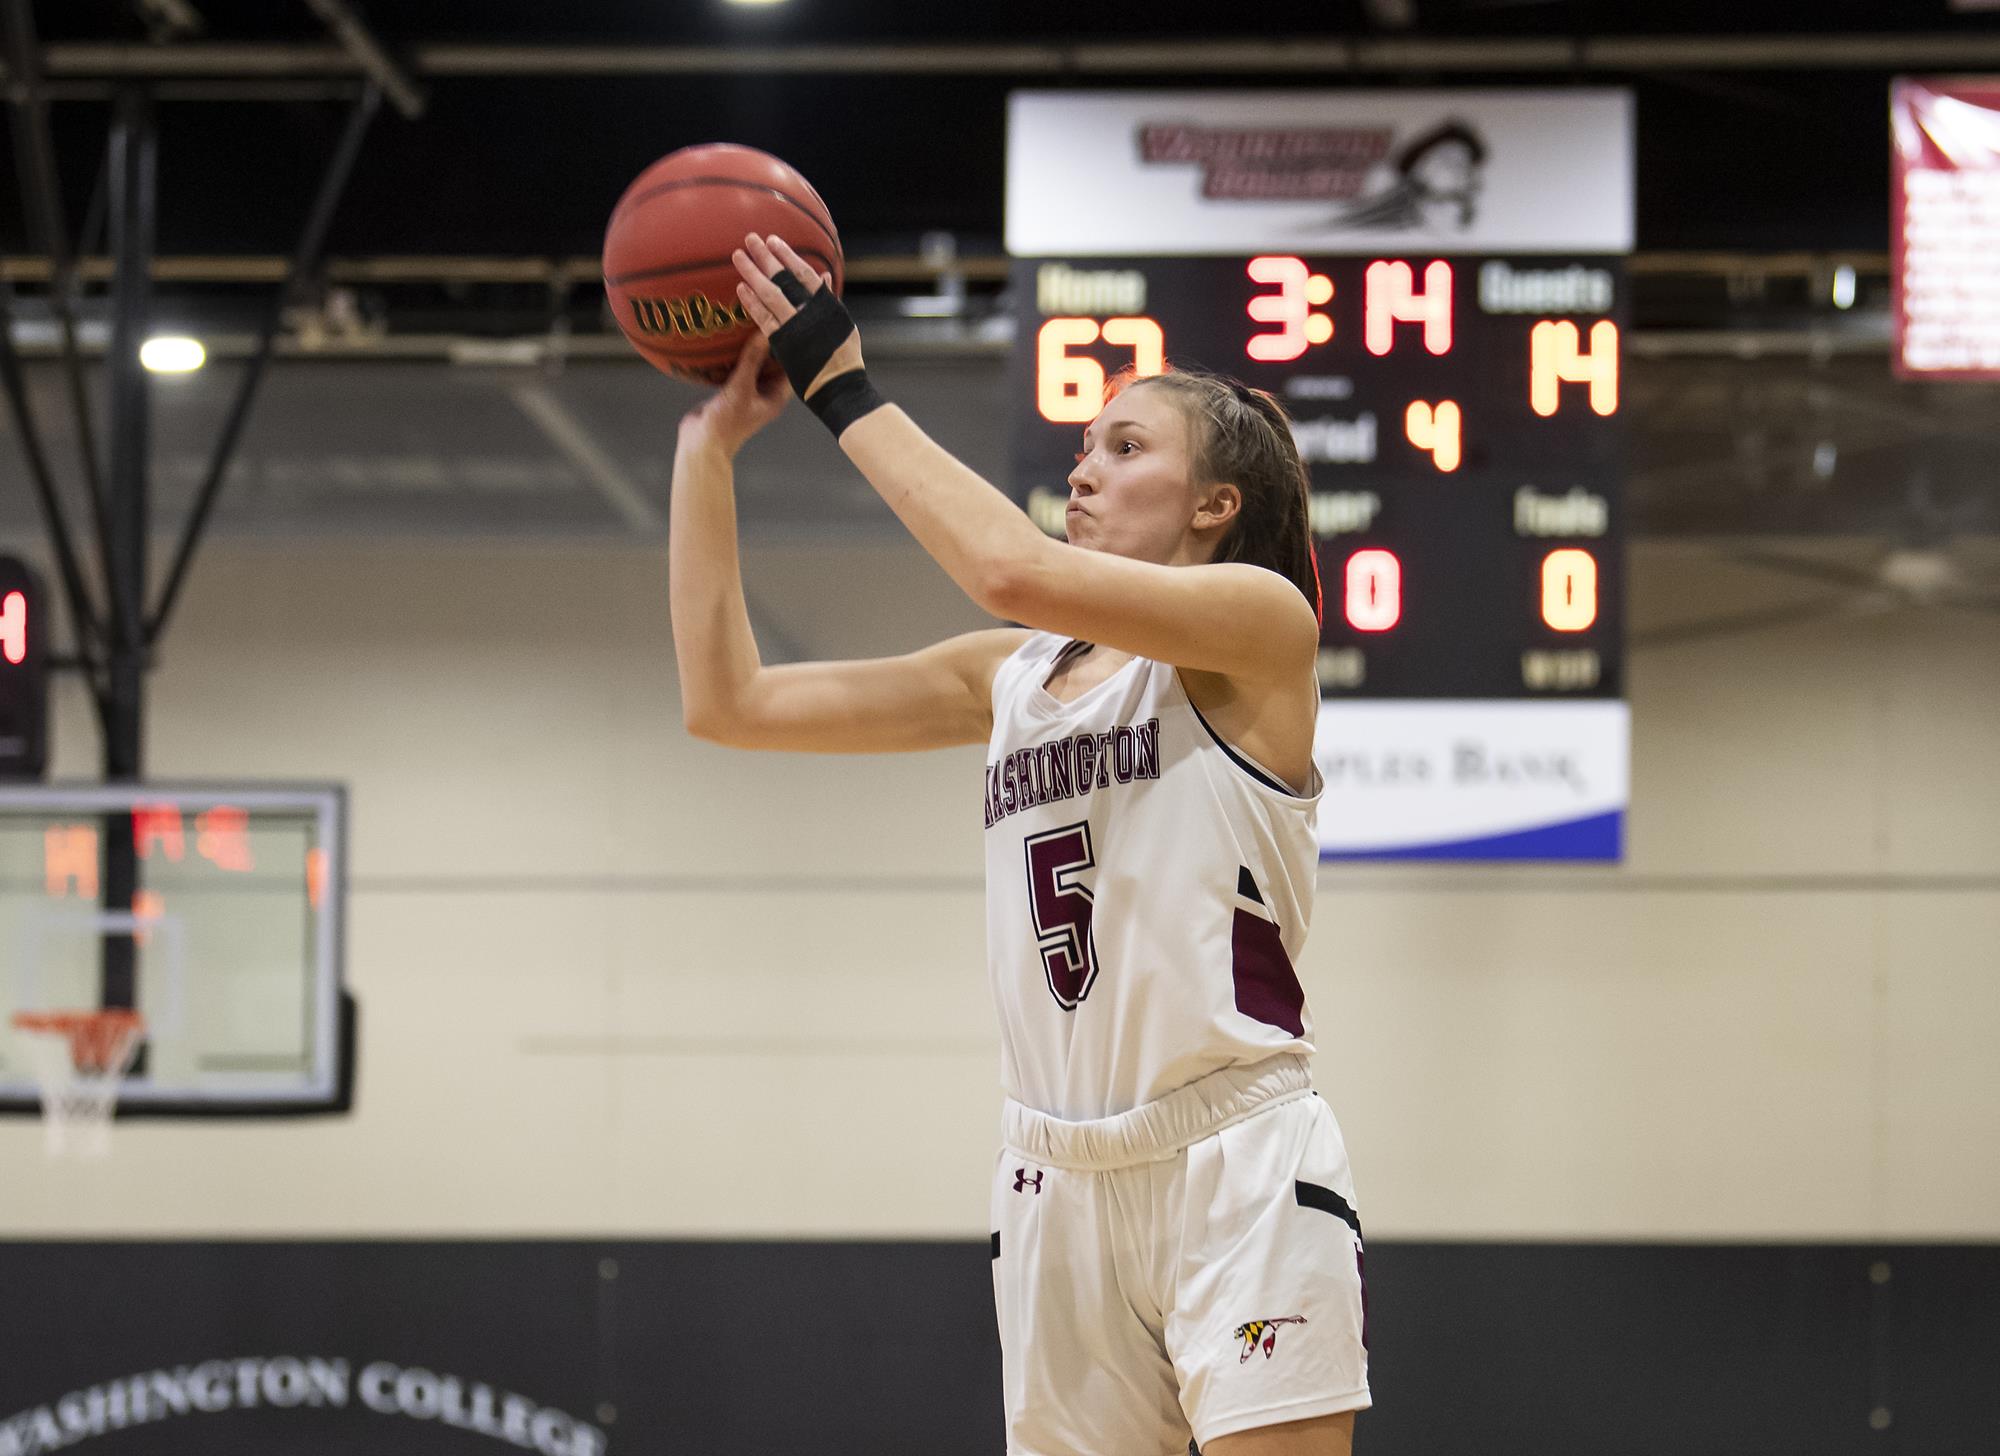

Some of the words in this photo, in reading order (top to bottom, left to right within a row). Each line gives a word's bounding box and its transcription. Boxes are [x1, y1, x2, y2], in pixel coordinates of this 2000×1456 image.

[630, 293, 750, 338] Wilso
[1038, 317, 1163, 423] 67
[1531, 319, 1618, 417] 14
[1406, 400, 1461, 473] 4
[1345, 548, 1400, 632] 0
[1541, 548, 1597, 632] 0
[1024, 820, 1099, 1012] 5
